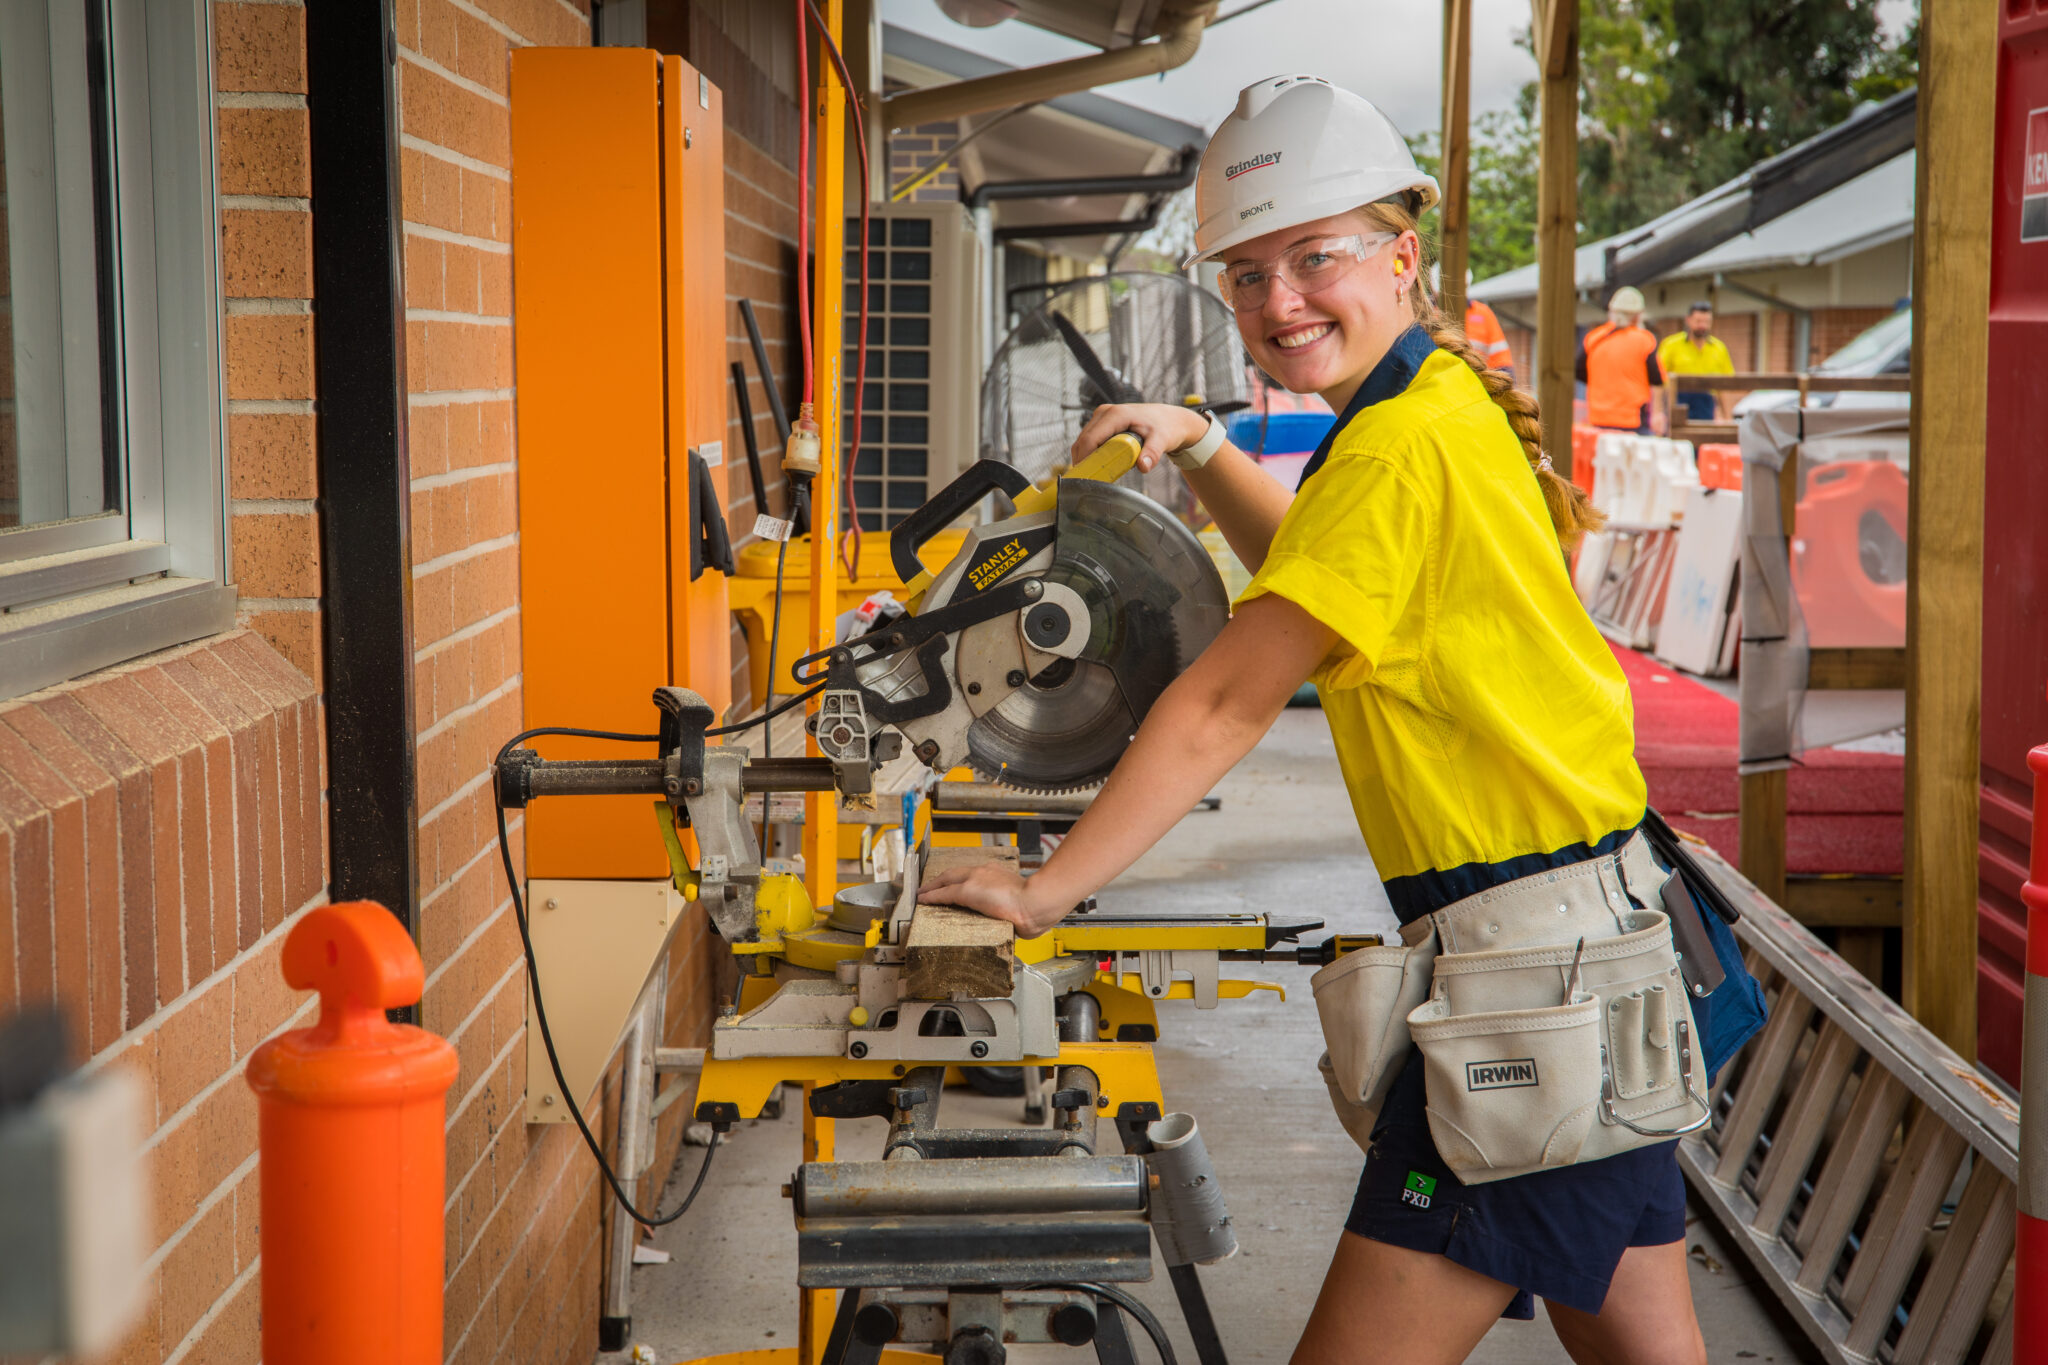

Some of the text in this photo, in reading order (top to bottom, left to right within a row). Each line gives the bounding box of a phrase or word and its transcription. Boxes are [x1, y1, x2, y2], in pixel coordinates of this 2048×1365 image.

[1225, 151, 1282, 177] Grindley
[1240, 201, 1274, 220] BRONTE
[968, 537, 1021, 583] STANLEY
[980, 553, 1022, 587] FATMAX
[1472, 1064, 1532, 1084] IRWIN
[1401, 1188, 1431, 1208] FXD
